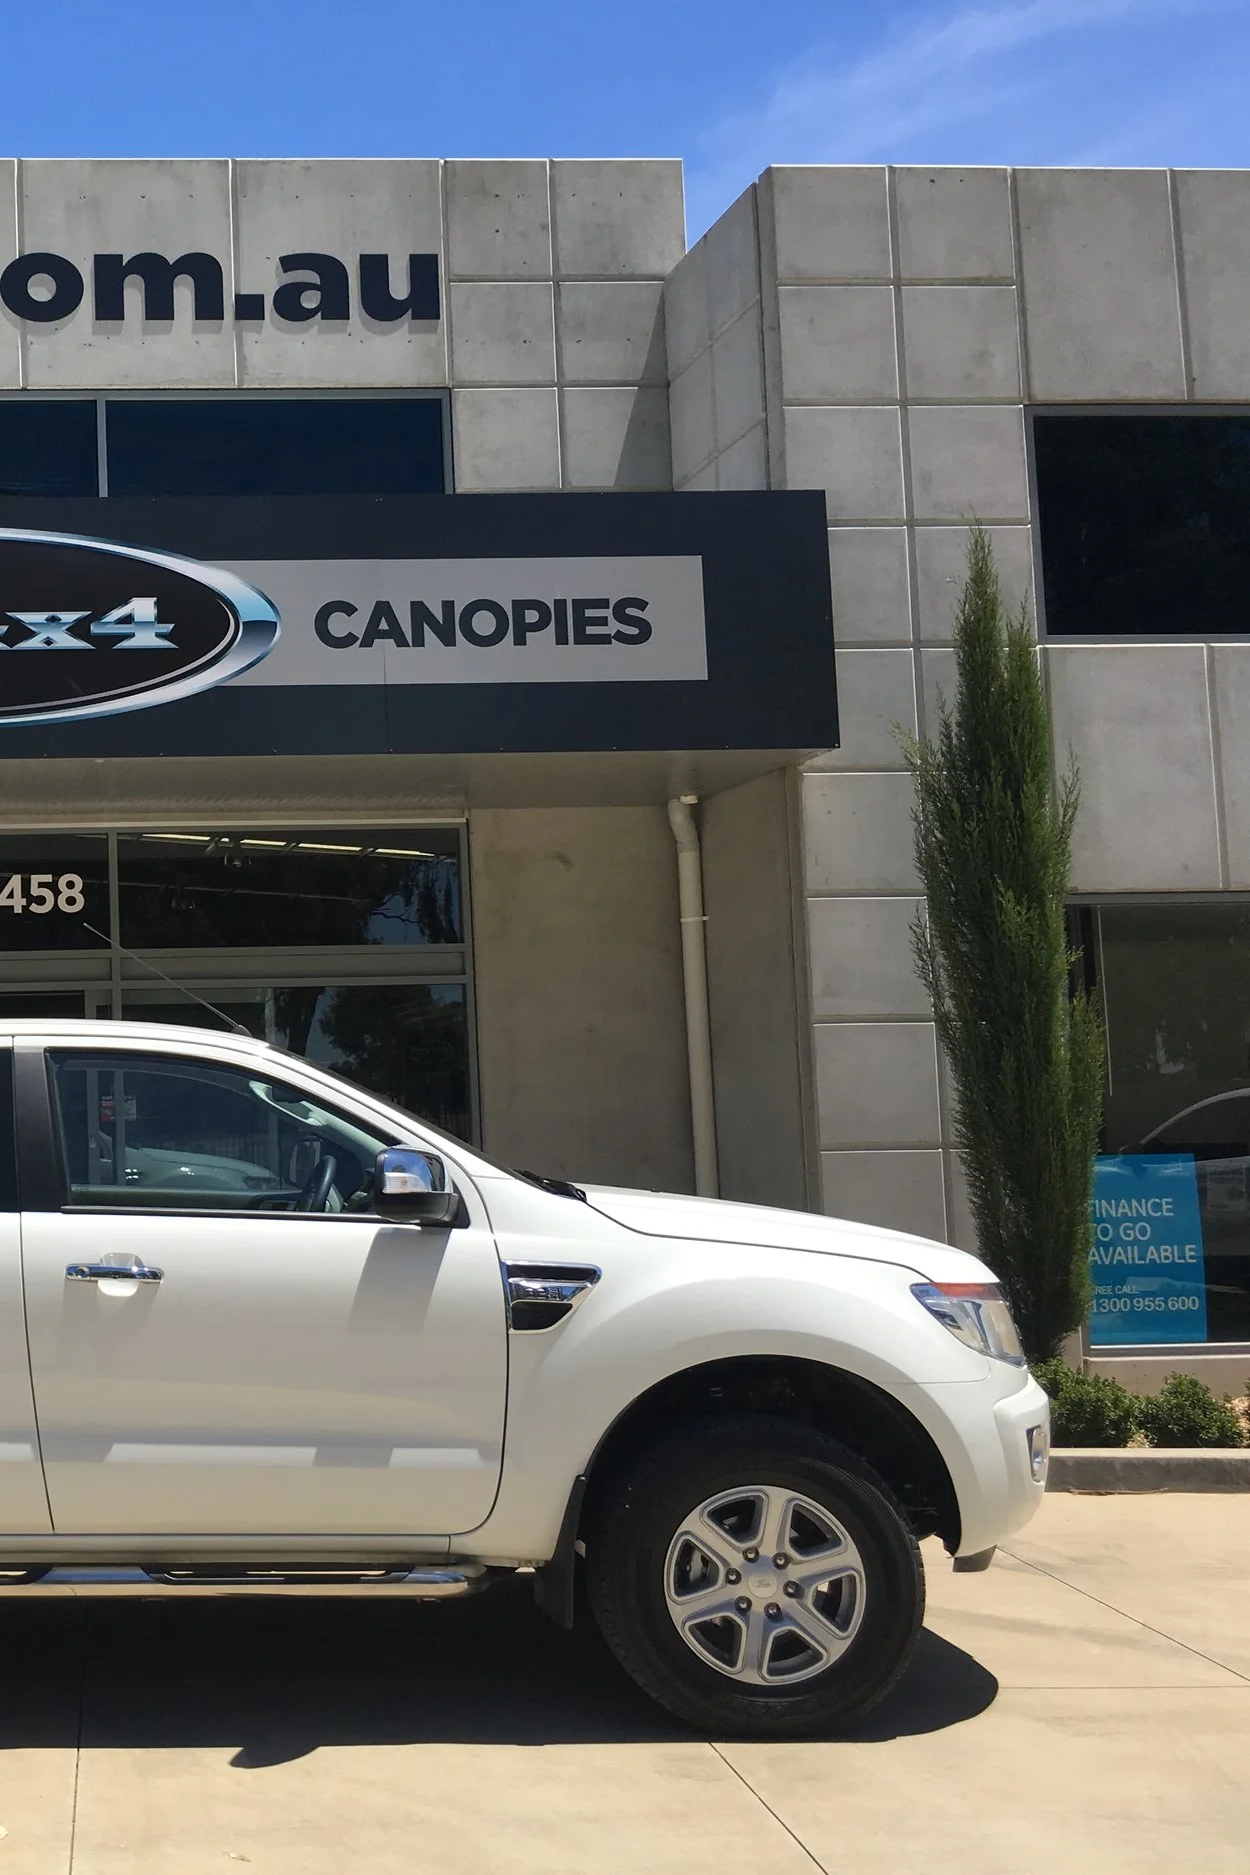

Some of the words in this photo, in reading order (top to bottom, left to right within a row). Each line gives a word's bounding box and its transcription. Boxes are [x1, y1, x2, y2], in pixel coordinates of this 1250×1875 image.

[314, 597, 653, 649] CANOPIES
[1119, 1222, 1151, 1241] GO
[1088, 1244, 1197, 1265] AVAILABLE
[1092, 1285, 1113, 1295] REE
[1090, 1298, 1131, 1313] 1300
[1133, 1297, 1166, 1312] 955
[1167, 1296, 1200, 1311] 600
